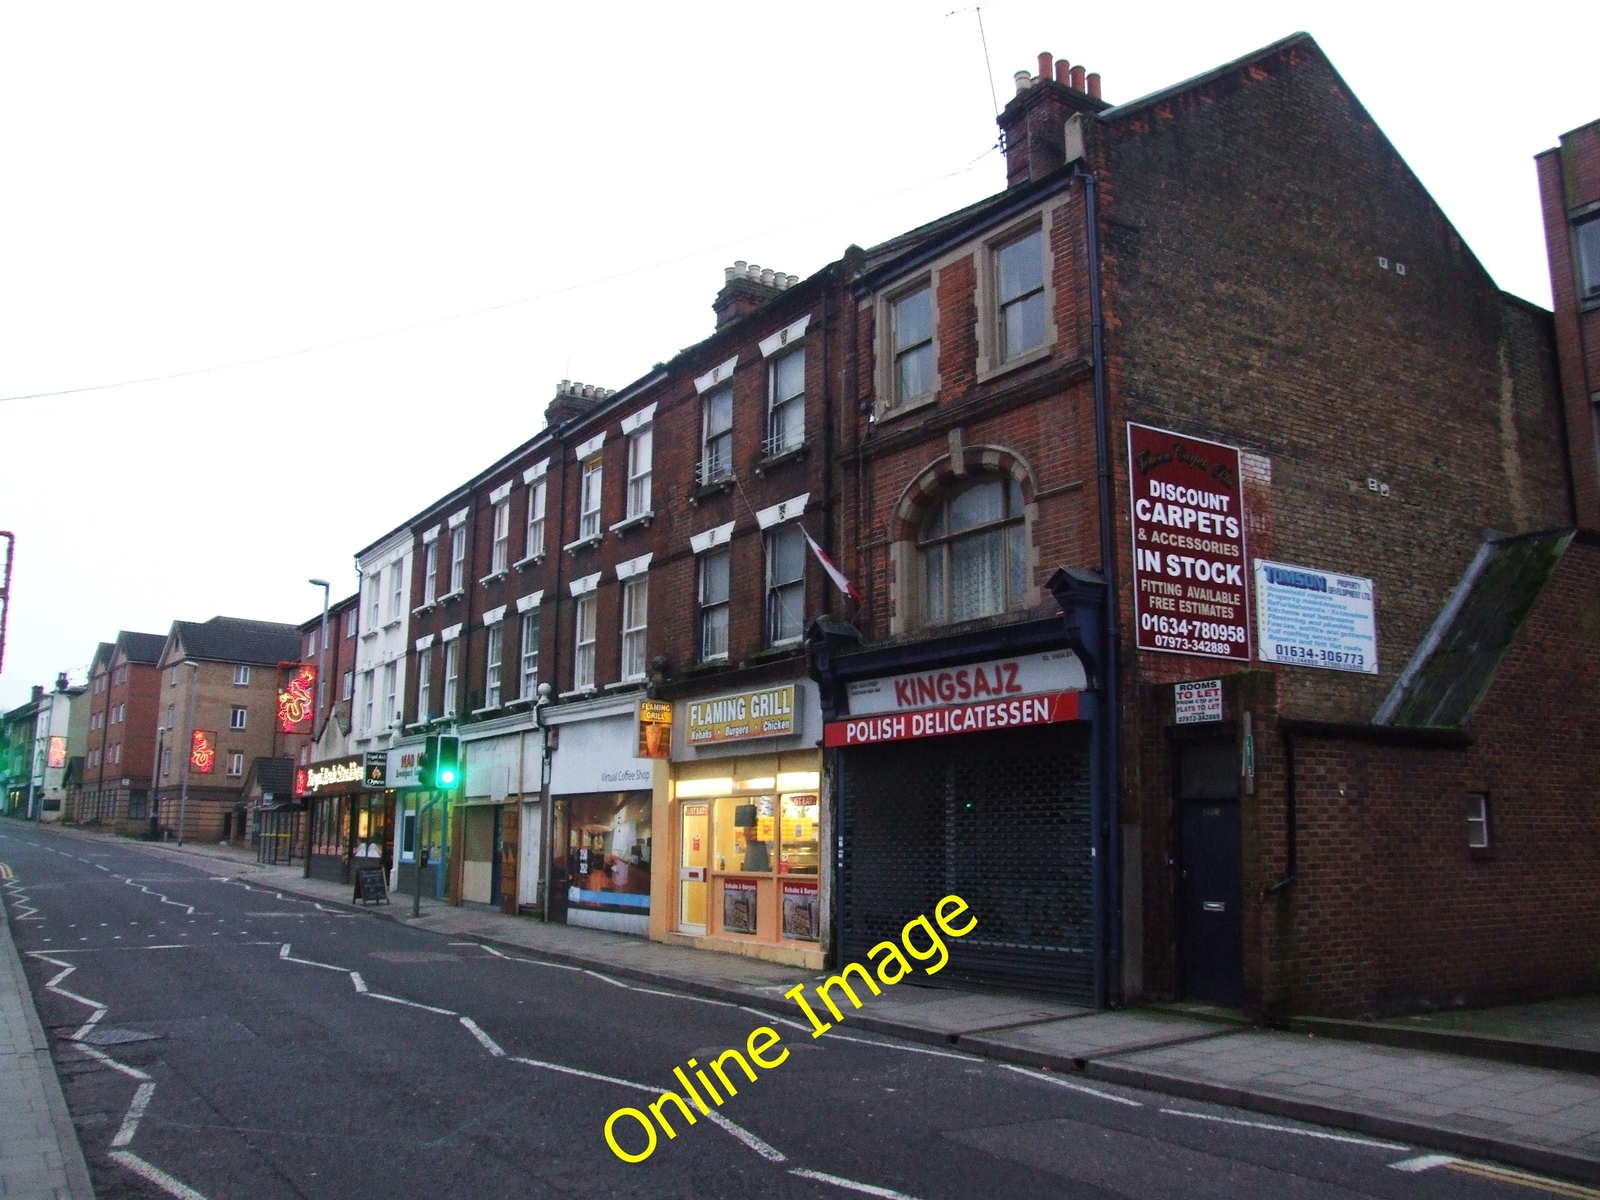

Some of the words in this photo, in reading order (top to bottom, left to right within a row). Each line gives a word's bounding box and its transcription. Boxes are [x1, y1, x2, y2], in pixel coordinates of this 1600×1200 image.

[1150, 480, 1230, 512] DISCOUNT
[1136, 499, 1239, 538] CARPETS
[1138, 528, 1147, 540] &
[1151, 531, 1239, 557] ACCESSORIES
[1137, 548, 1161, 573] IN
[1166, 554, 1242, 586] STOCK
[1263, 566, 1327, 592] TOMSON
[1141, 579, 1182, 596] FITTING
[1187, 586, 1240, 606] AVAILABLE
[1267, 592, 1299, 603] Property
[1149, 596, 1175, 611] FREE
[1179, 600, 1234, 619] ESTIMATES
[1267, 606, 1299, 616] Kitchens
[1142, 613, 1245, 643] 01634-780958
[1155, 634, 1230, 654] 07973-342889
[1276, 644, 1364, 665] 01634-306773
[894, 662, 1022, 707] KINGSAJZ
[1177, 691, 1193, 699] TO
[1197, 688, 1220, 698] LET
[1180, 681, 1217, 691] ROOMS
[641, 703, 671, 712] FLAMING
[646, 712, 665, 720] GRILL
[690, 698, 746, 726] FLAMING
[750, 690, 790, 718] GRILL
[691, 730, 712, 740] Kebabs
[725, 725, 749, 737] Burgers
[763, 720, 789, 732] Chicken
[846, 716, 905, 743] POLISH
[912, 698, 1048, 735] DELICATESSEN
[601, 772, 617, 782] Virtual
[618, 770, 635, 781] Coffee
[636, 769, 650, 781] Shop
